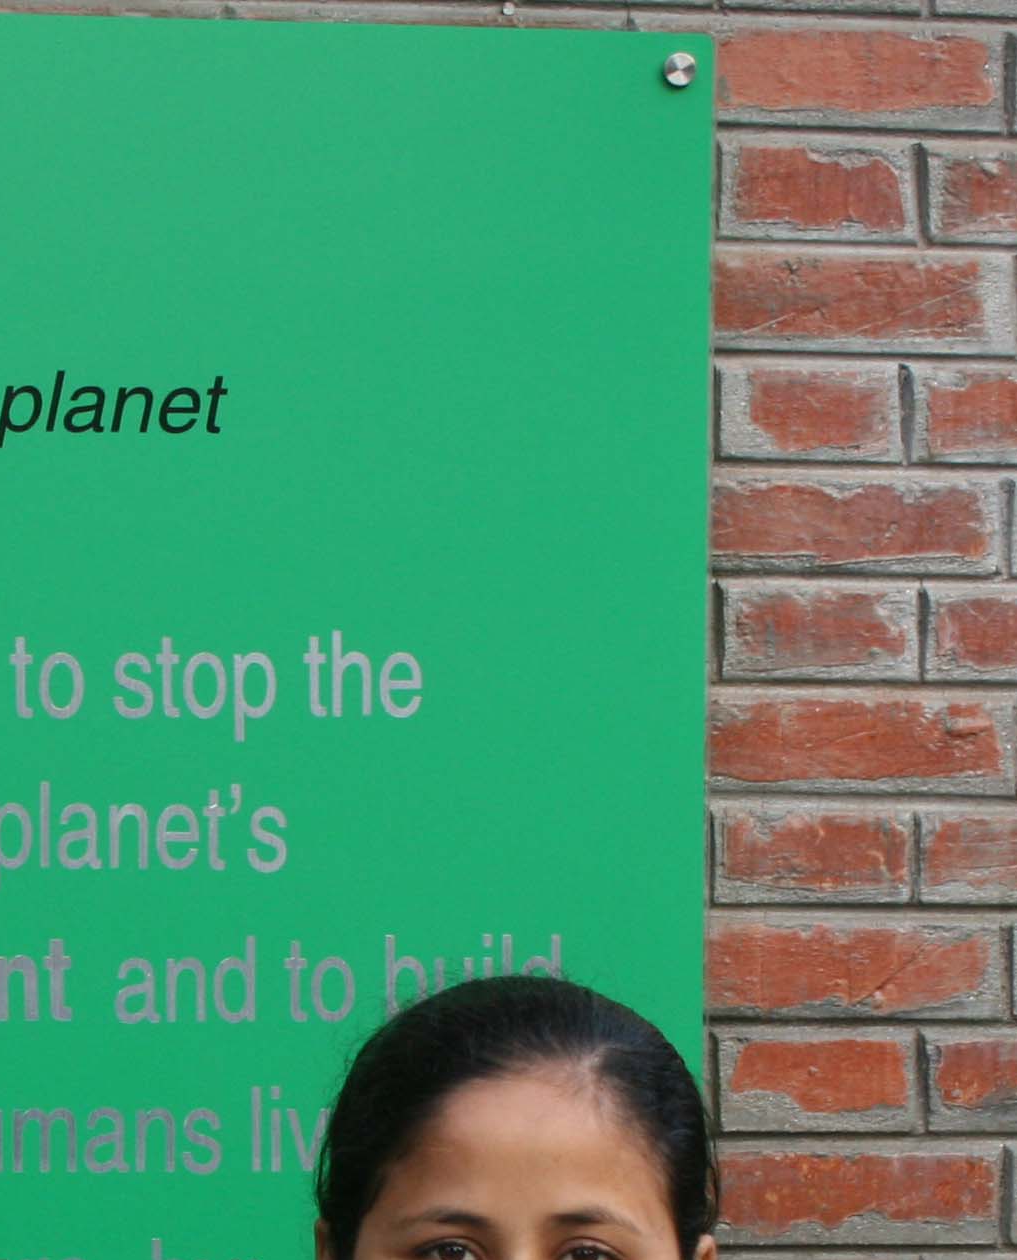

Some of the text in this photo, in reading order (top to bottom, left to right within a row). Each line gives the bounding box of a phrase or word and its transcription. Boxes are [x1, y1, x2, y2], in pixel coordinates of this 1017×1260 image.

[10, 636, 84, 719] to
[114, 636, 276, 742] stop
[304, 630, 423, 718] the
[115, 936, 256, 1024] and
[285, 941, 355, 1023] to
[251, 1085, 332, 1173] liv
